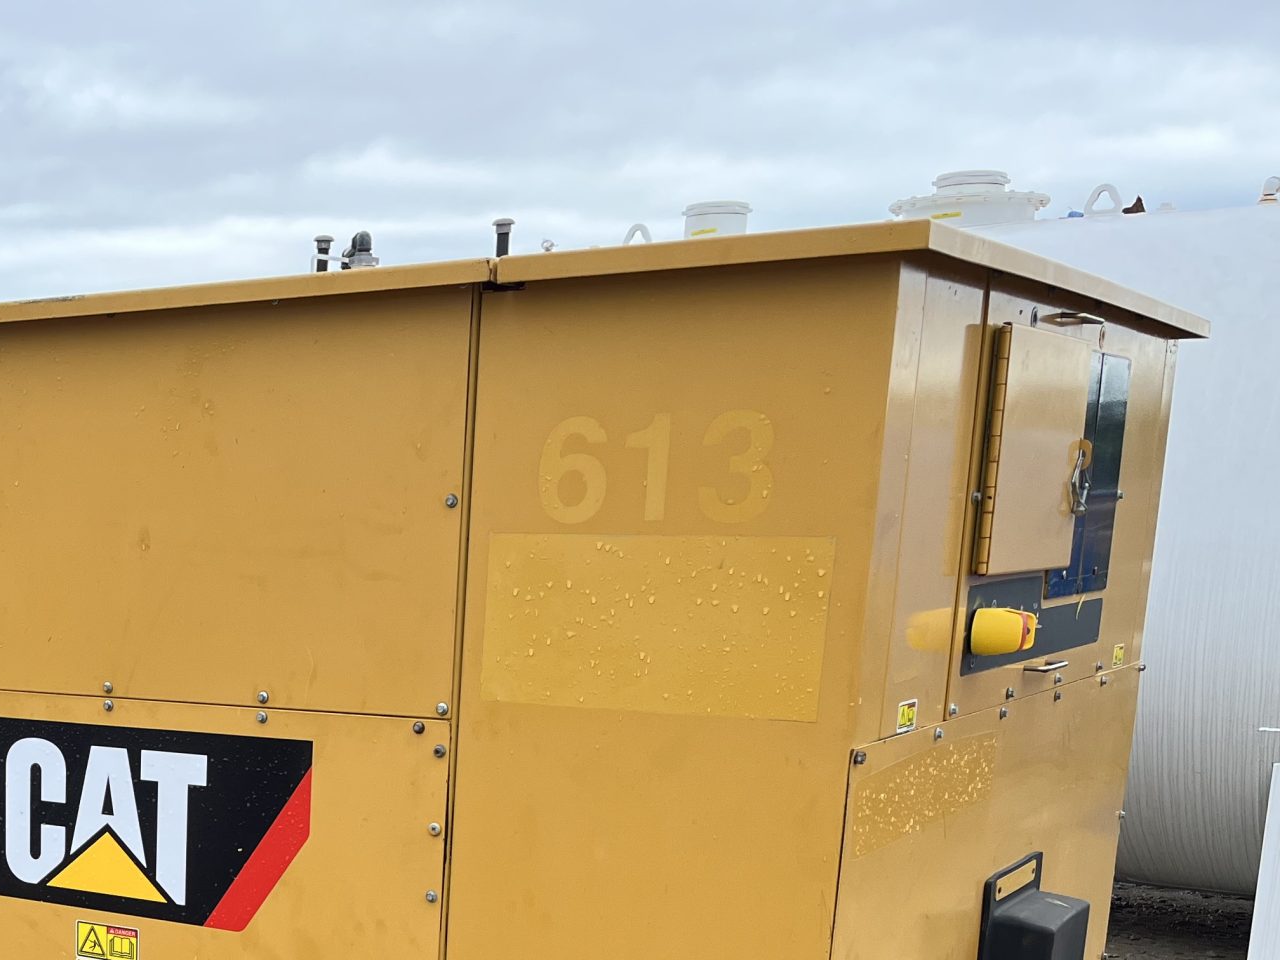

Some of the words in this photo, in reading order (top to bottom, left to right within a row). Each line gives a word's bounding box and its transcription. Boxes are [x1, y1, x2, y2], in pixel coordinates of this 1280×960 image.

[538, 409, 776, 525] 613
[5, 737, 208, 906] CAT
[115, 928, 136, 937] DANGER
